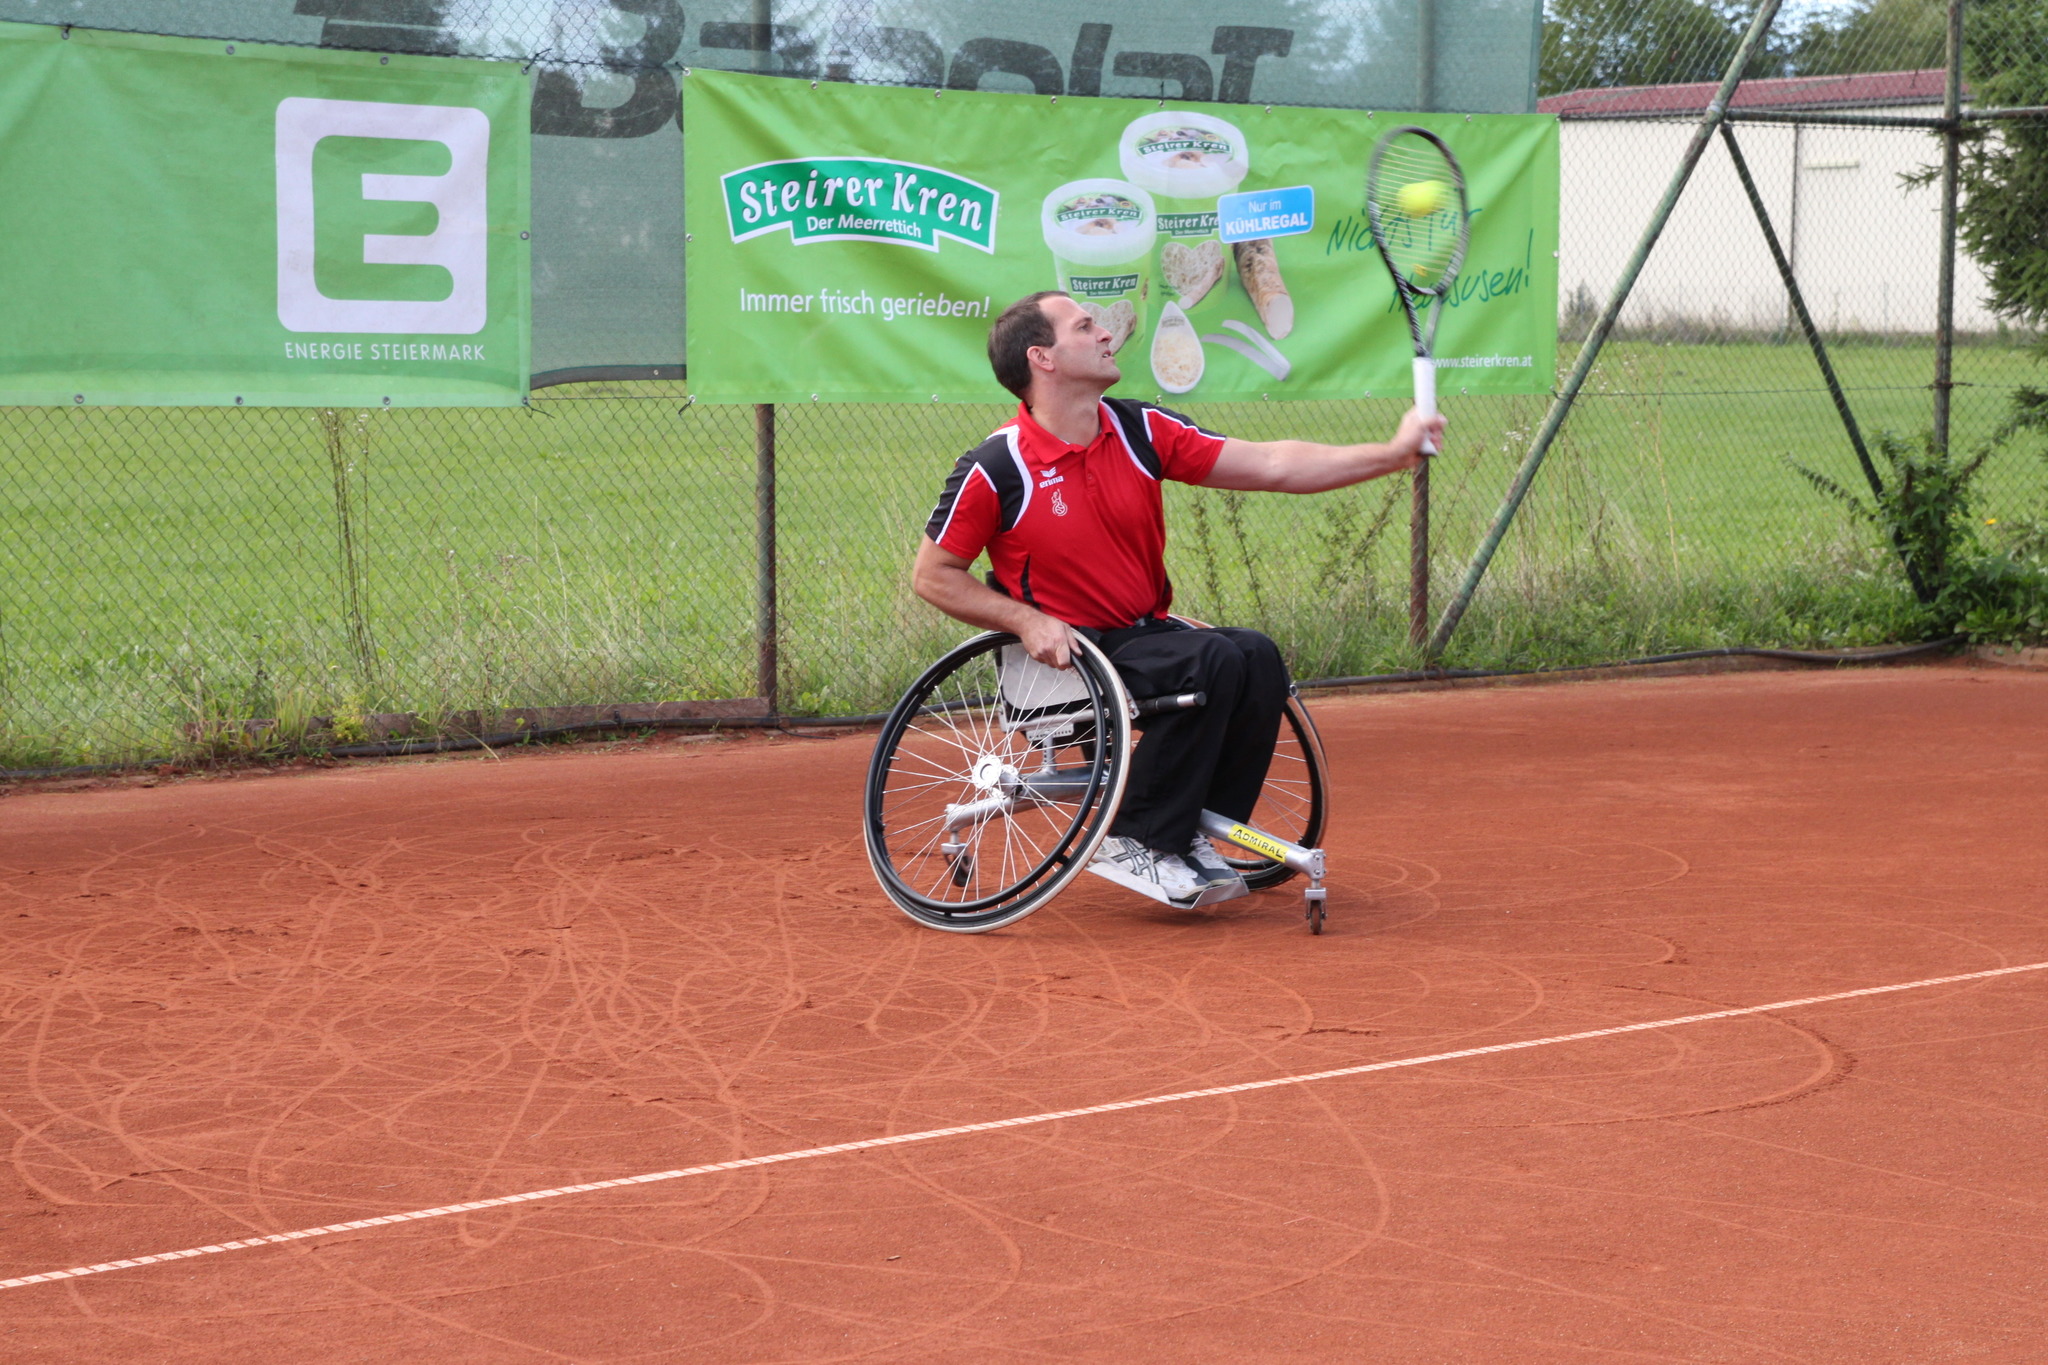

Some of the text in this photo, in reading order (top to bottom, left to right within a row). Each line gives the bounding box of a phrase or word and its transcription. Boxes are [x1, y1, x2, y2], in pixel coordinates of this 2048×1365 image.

[739, 169, 982, 231] Steirer Kren
[1248, 200, 1282, 213] Nur im
[806, 214, 922, 239] Der Meerrettich
[1157, 214, 1219, 230] Steirer Kre
[1225, 213, 1308, 235] KÜHLREGAL
[1072, 278, 1136, 291] Steirer Kren
[740, 288, 990, 321] Immer frisch gerieben!
[284, 342, 486, 361] ENERGIE STEIERMARK
[1434, 353, 1533, 369] www.steirerkren.at
[1039, 475, 1064, 488] erima
[1233, 829, 1284, 859] ADMIRAL
